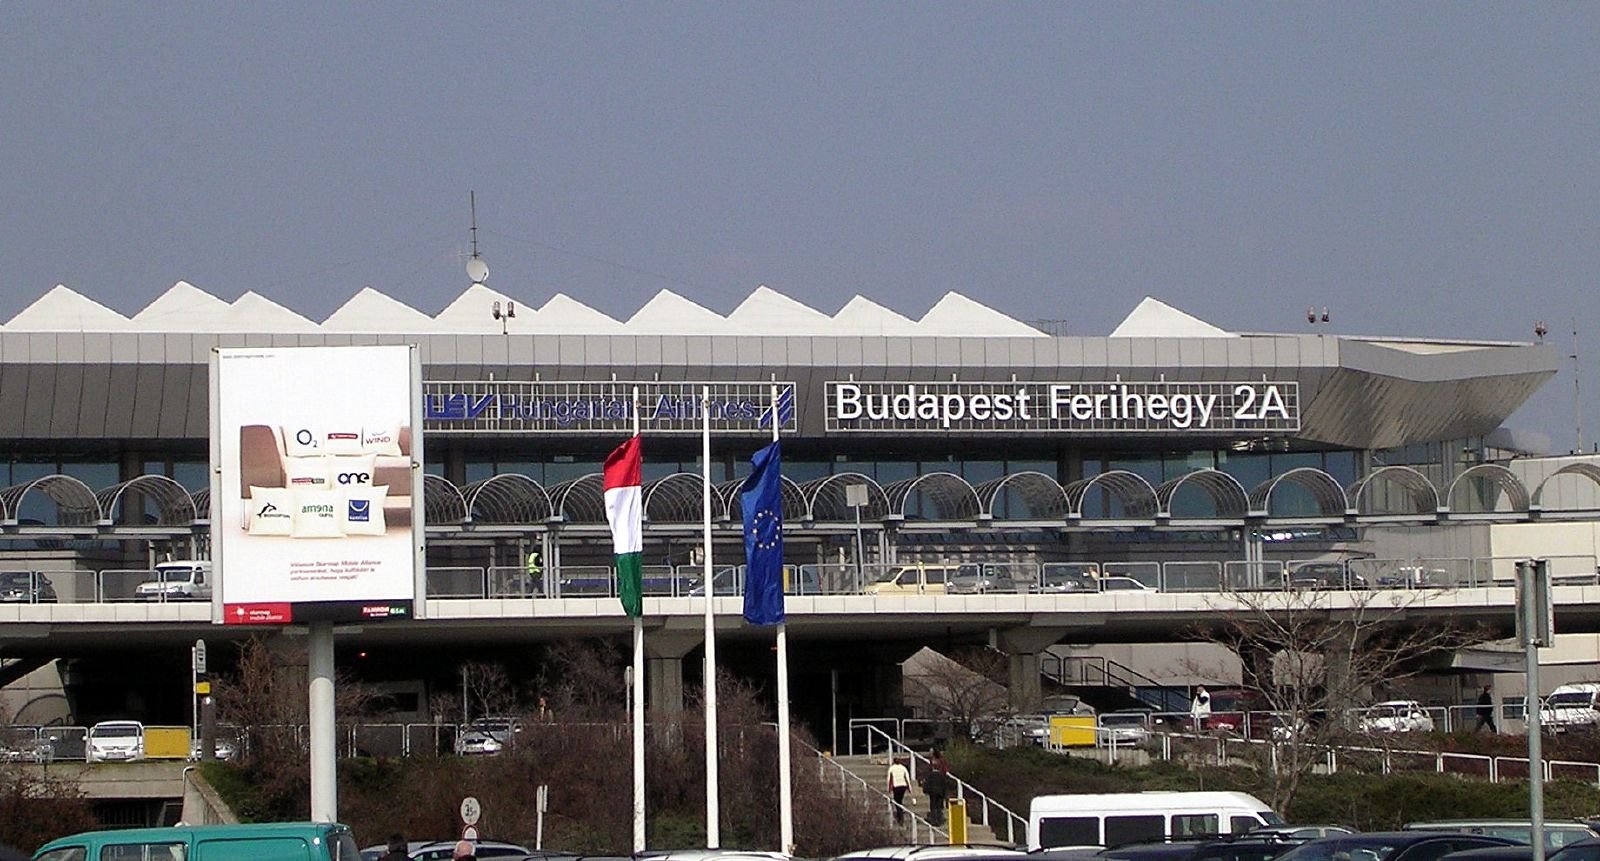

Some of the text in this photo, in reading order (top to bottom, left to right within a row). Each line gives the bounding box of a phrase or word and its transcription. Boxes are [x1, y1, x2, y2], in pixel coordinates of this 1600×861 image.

[652, 394, 756, 420] Airlnes
[836, 384, 1289, 428] Budapest Ferihegy 2A
[338, 472, 370, 485] one
